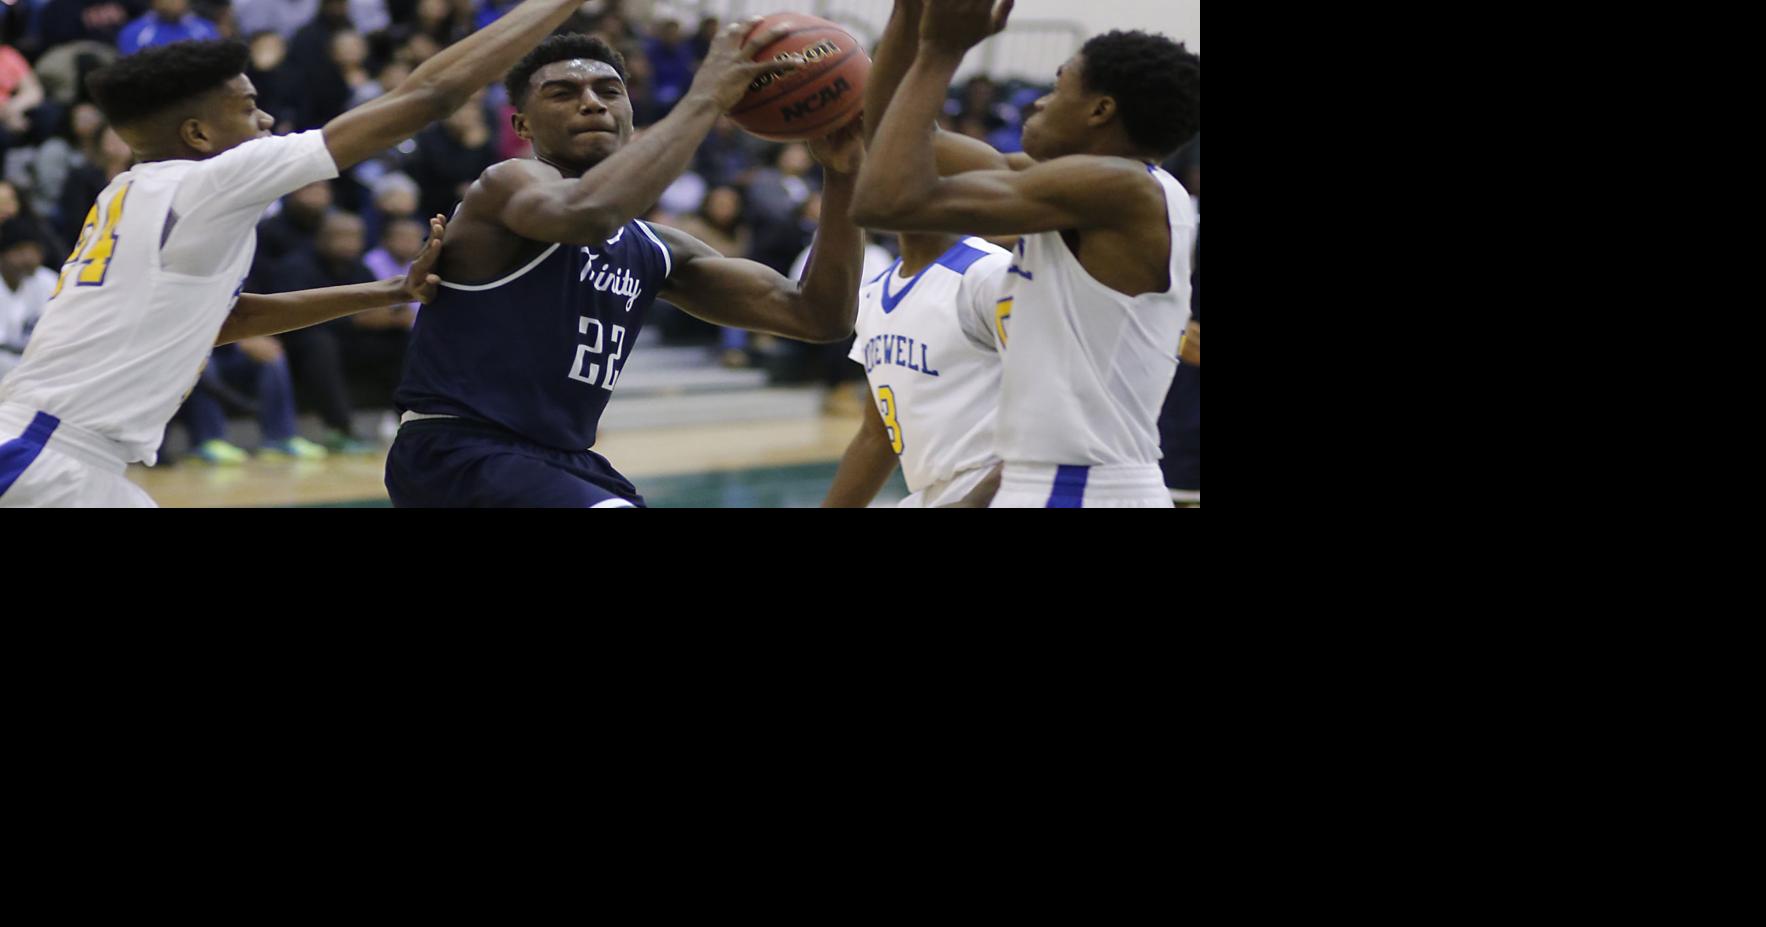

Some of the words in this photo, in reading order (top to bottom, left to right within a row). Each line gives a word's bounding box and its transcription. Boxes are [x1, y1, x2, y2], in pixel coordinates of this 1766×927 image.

[749, 39, 842, 93] Wilon
[780, 76, 851, 122] NCAA
[568, 315, 626, 392] 22
